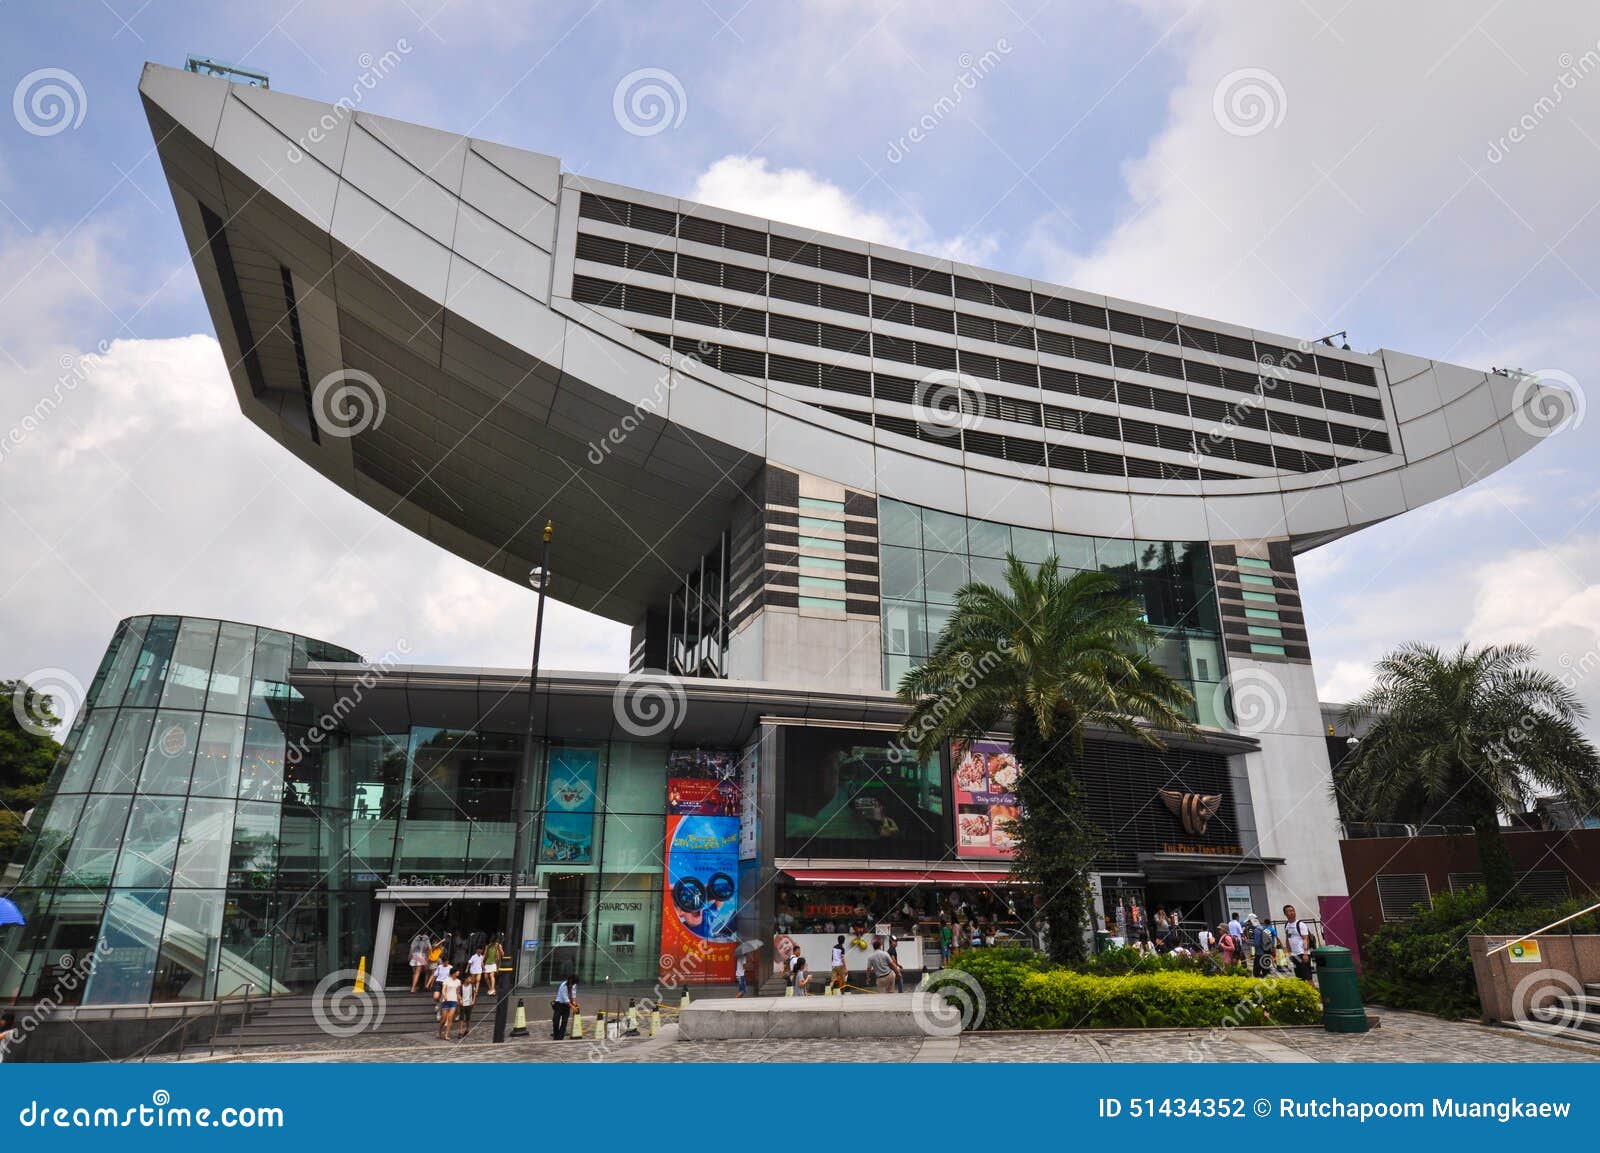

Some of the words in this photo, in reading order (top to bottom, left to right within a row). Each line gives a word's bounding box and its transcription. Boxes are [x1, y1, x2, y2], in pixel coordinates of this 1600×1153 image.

[388, 875, 407, 886] The
[410, 875, 435, 886] Peak
[438, 875, 471, 886] Tower
[599, 902, 643, 911] SWAROVSKI
